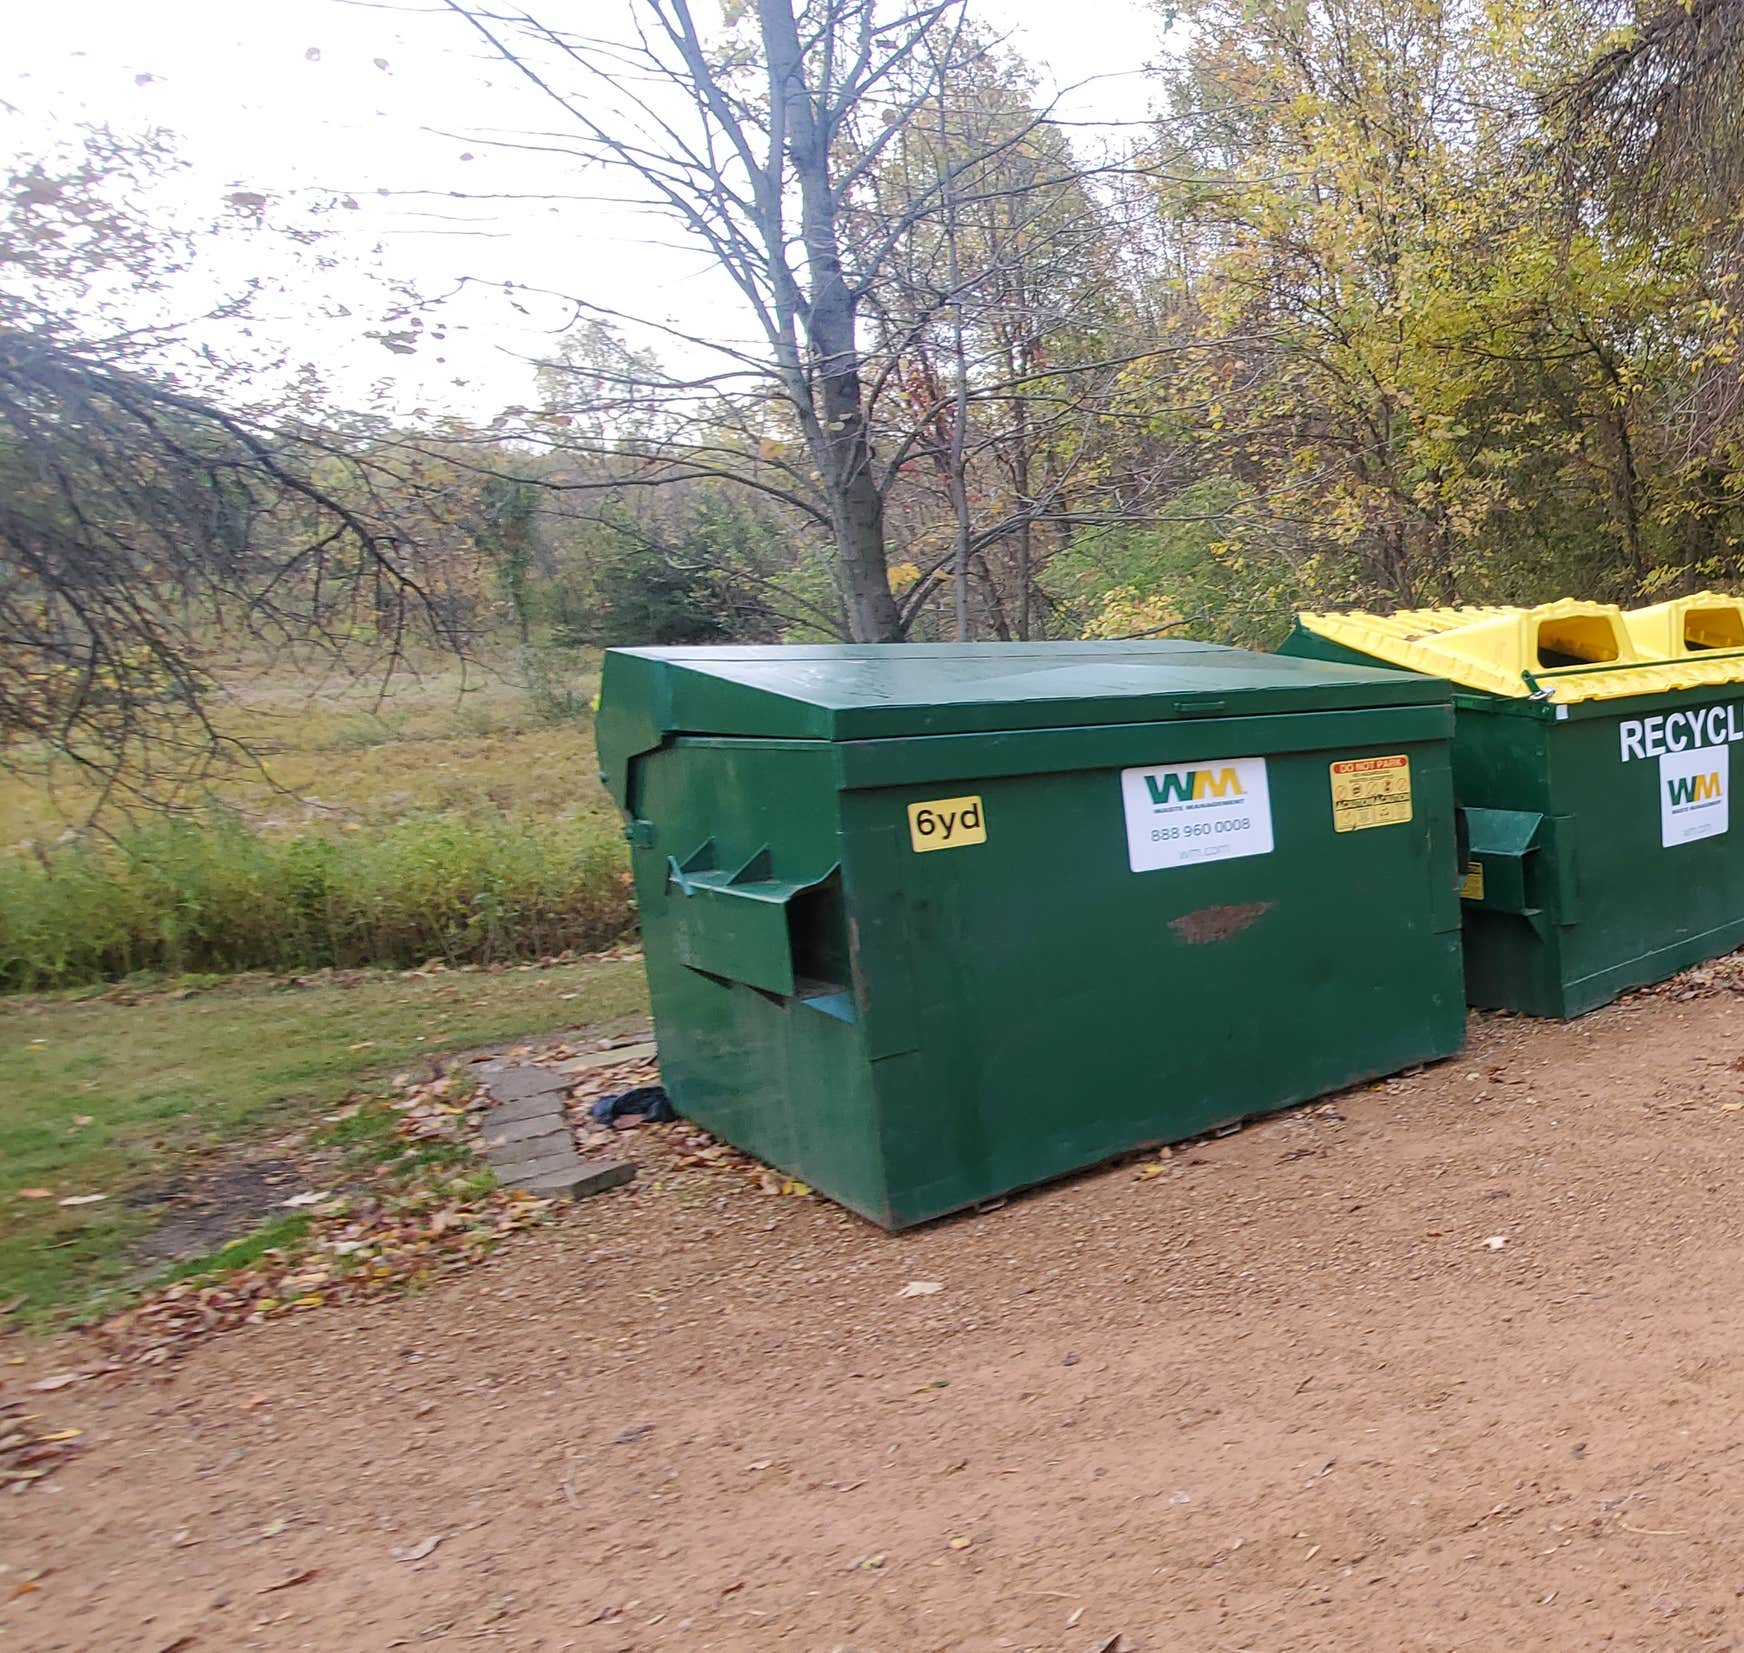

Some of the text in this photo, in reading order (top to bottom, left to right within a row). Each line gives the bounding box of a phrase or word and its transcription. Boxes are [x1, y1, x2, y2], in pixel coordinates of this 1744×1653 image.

[1143, 767, 1244, 805] WM
[1667, 771, 1721, 806] WM
[917, 803, 980, 839] 6yd
[1151, 818, 1251, 842] 888 960 0008
